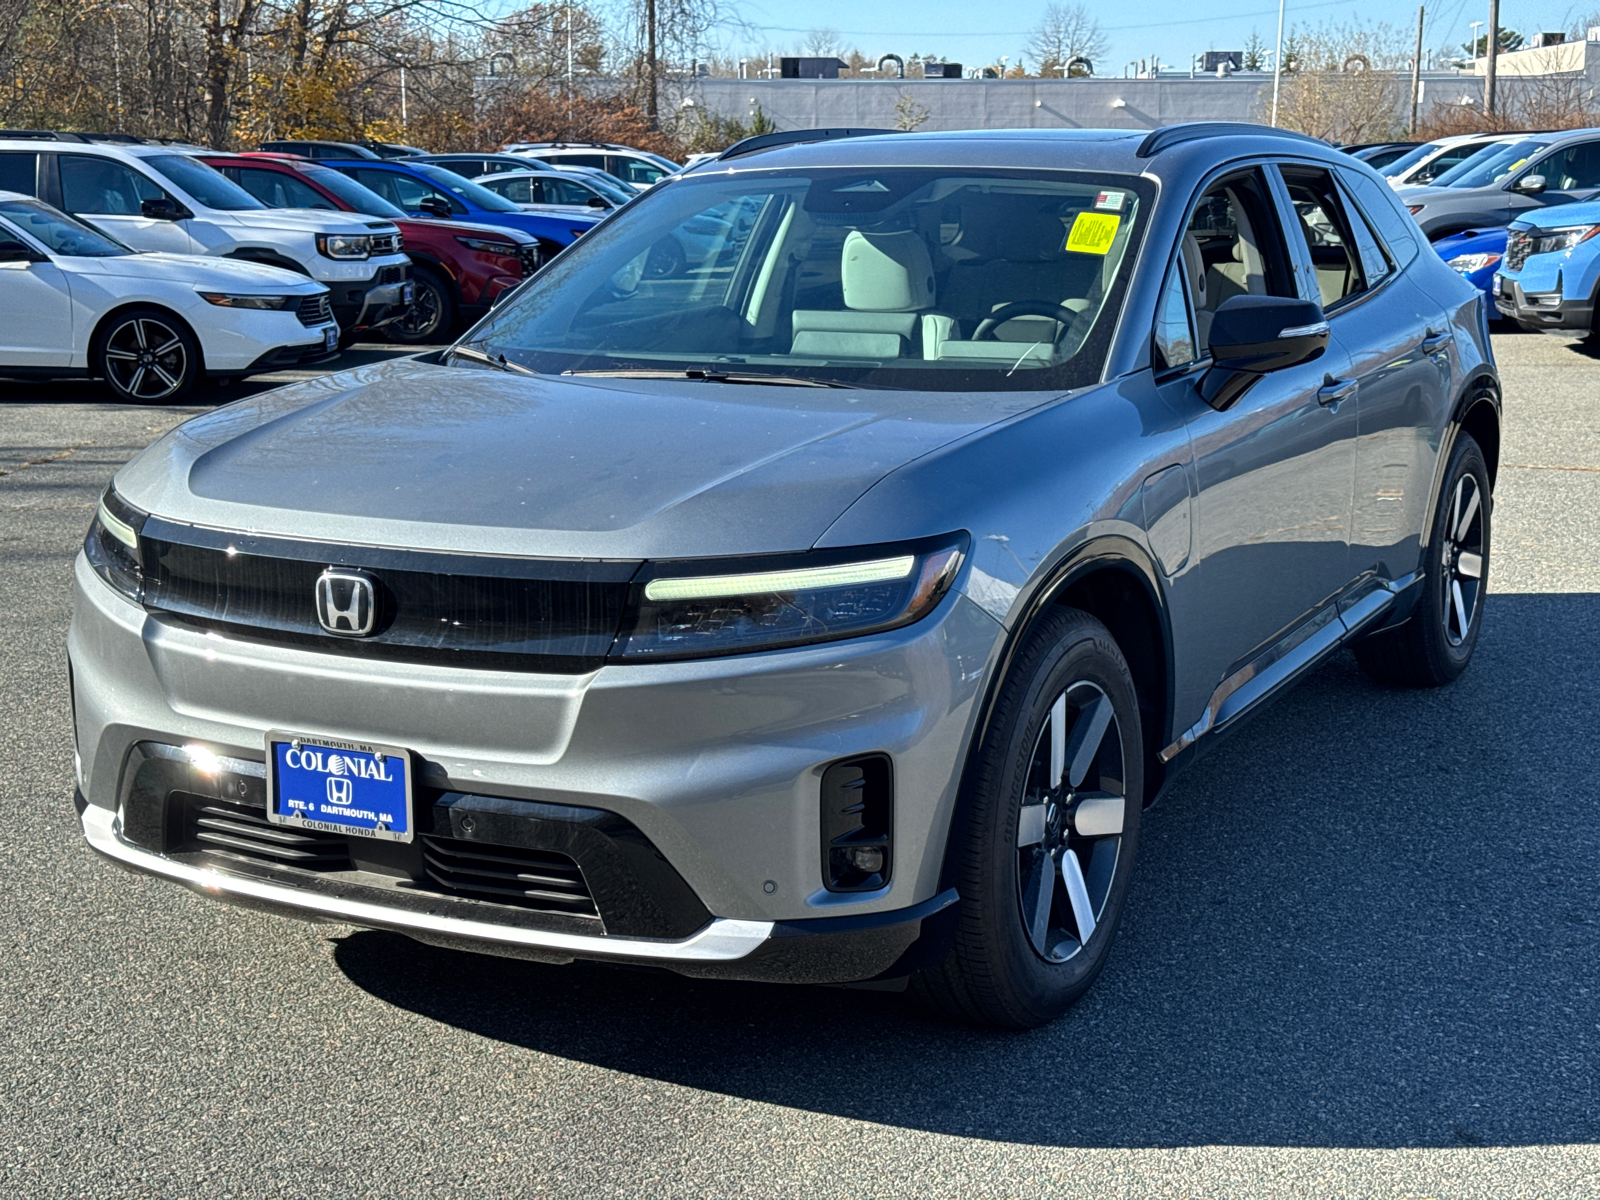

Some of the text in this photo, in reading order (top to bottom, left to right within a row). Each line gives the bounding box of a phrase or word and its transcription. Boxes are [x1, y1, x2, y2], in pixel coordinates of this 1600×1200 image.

[360, 745, 374, 753] MA
[285, 749, 393, 782] COLONIAL
[1003, 715, 1034, 844] BRIDGESTONE
[288, 799, 393, 823] RTE. 6 DARTMOUTH, MA
[302, 819, 376, 837] COLONIAL HONDA
